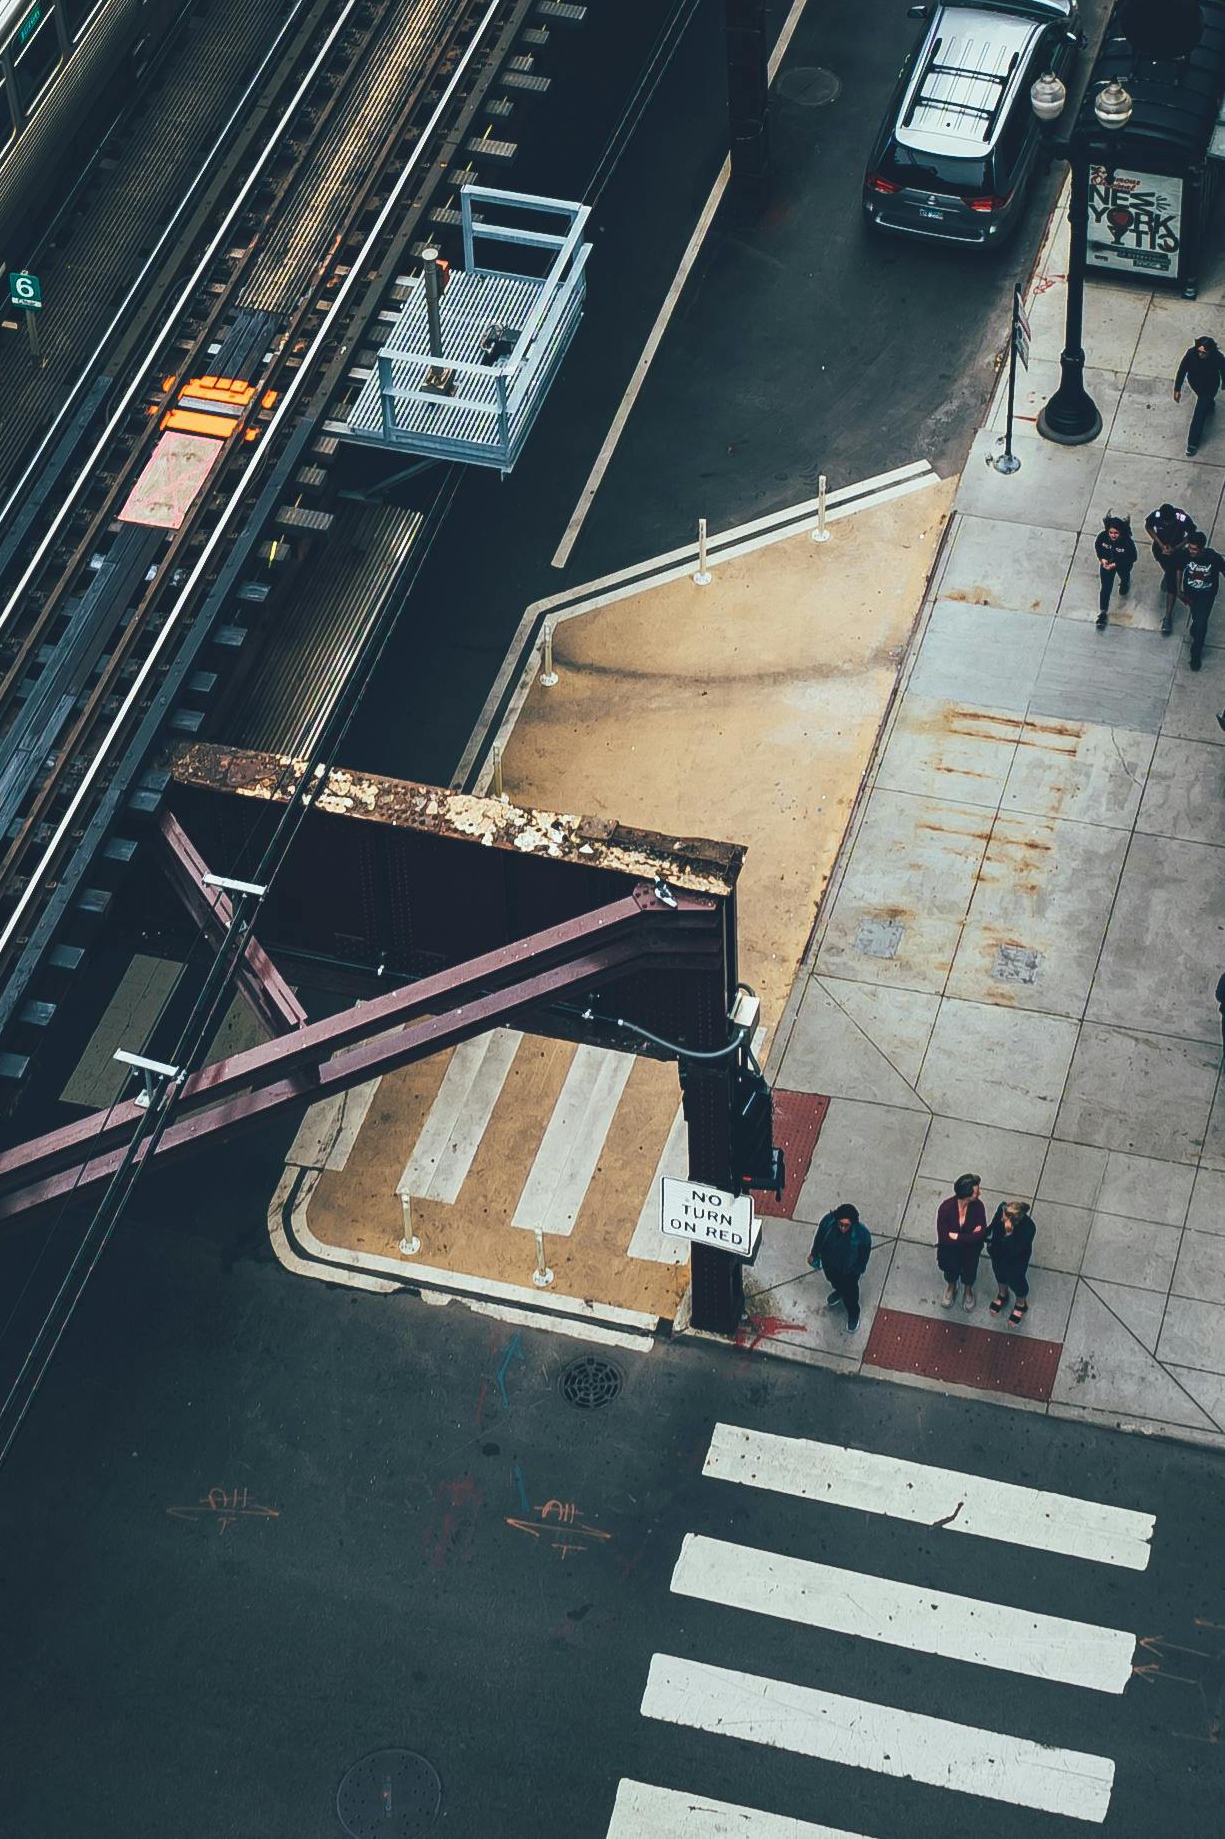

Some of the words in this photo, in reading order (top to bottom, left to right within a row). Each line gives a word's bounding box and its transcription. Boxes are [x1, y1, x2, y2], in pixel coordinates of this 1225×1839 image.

[15, 277, 34, 298] 6
[692, 1190, 722, 1207] NO
[682, 1203, 732, 1226] TURN
[670, 1218, 696, 1233] ON
[706, 1226, 742, 1245] RED
